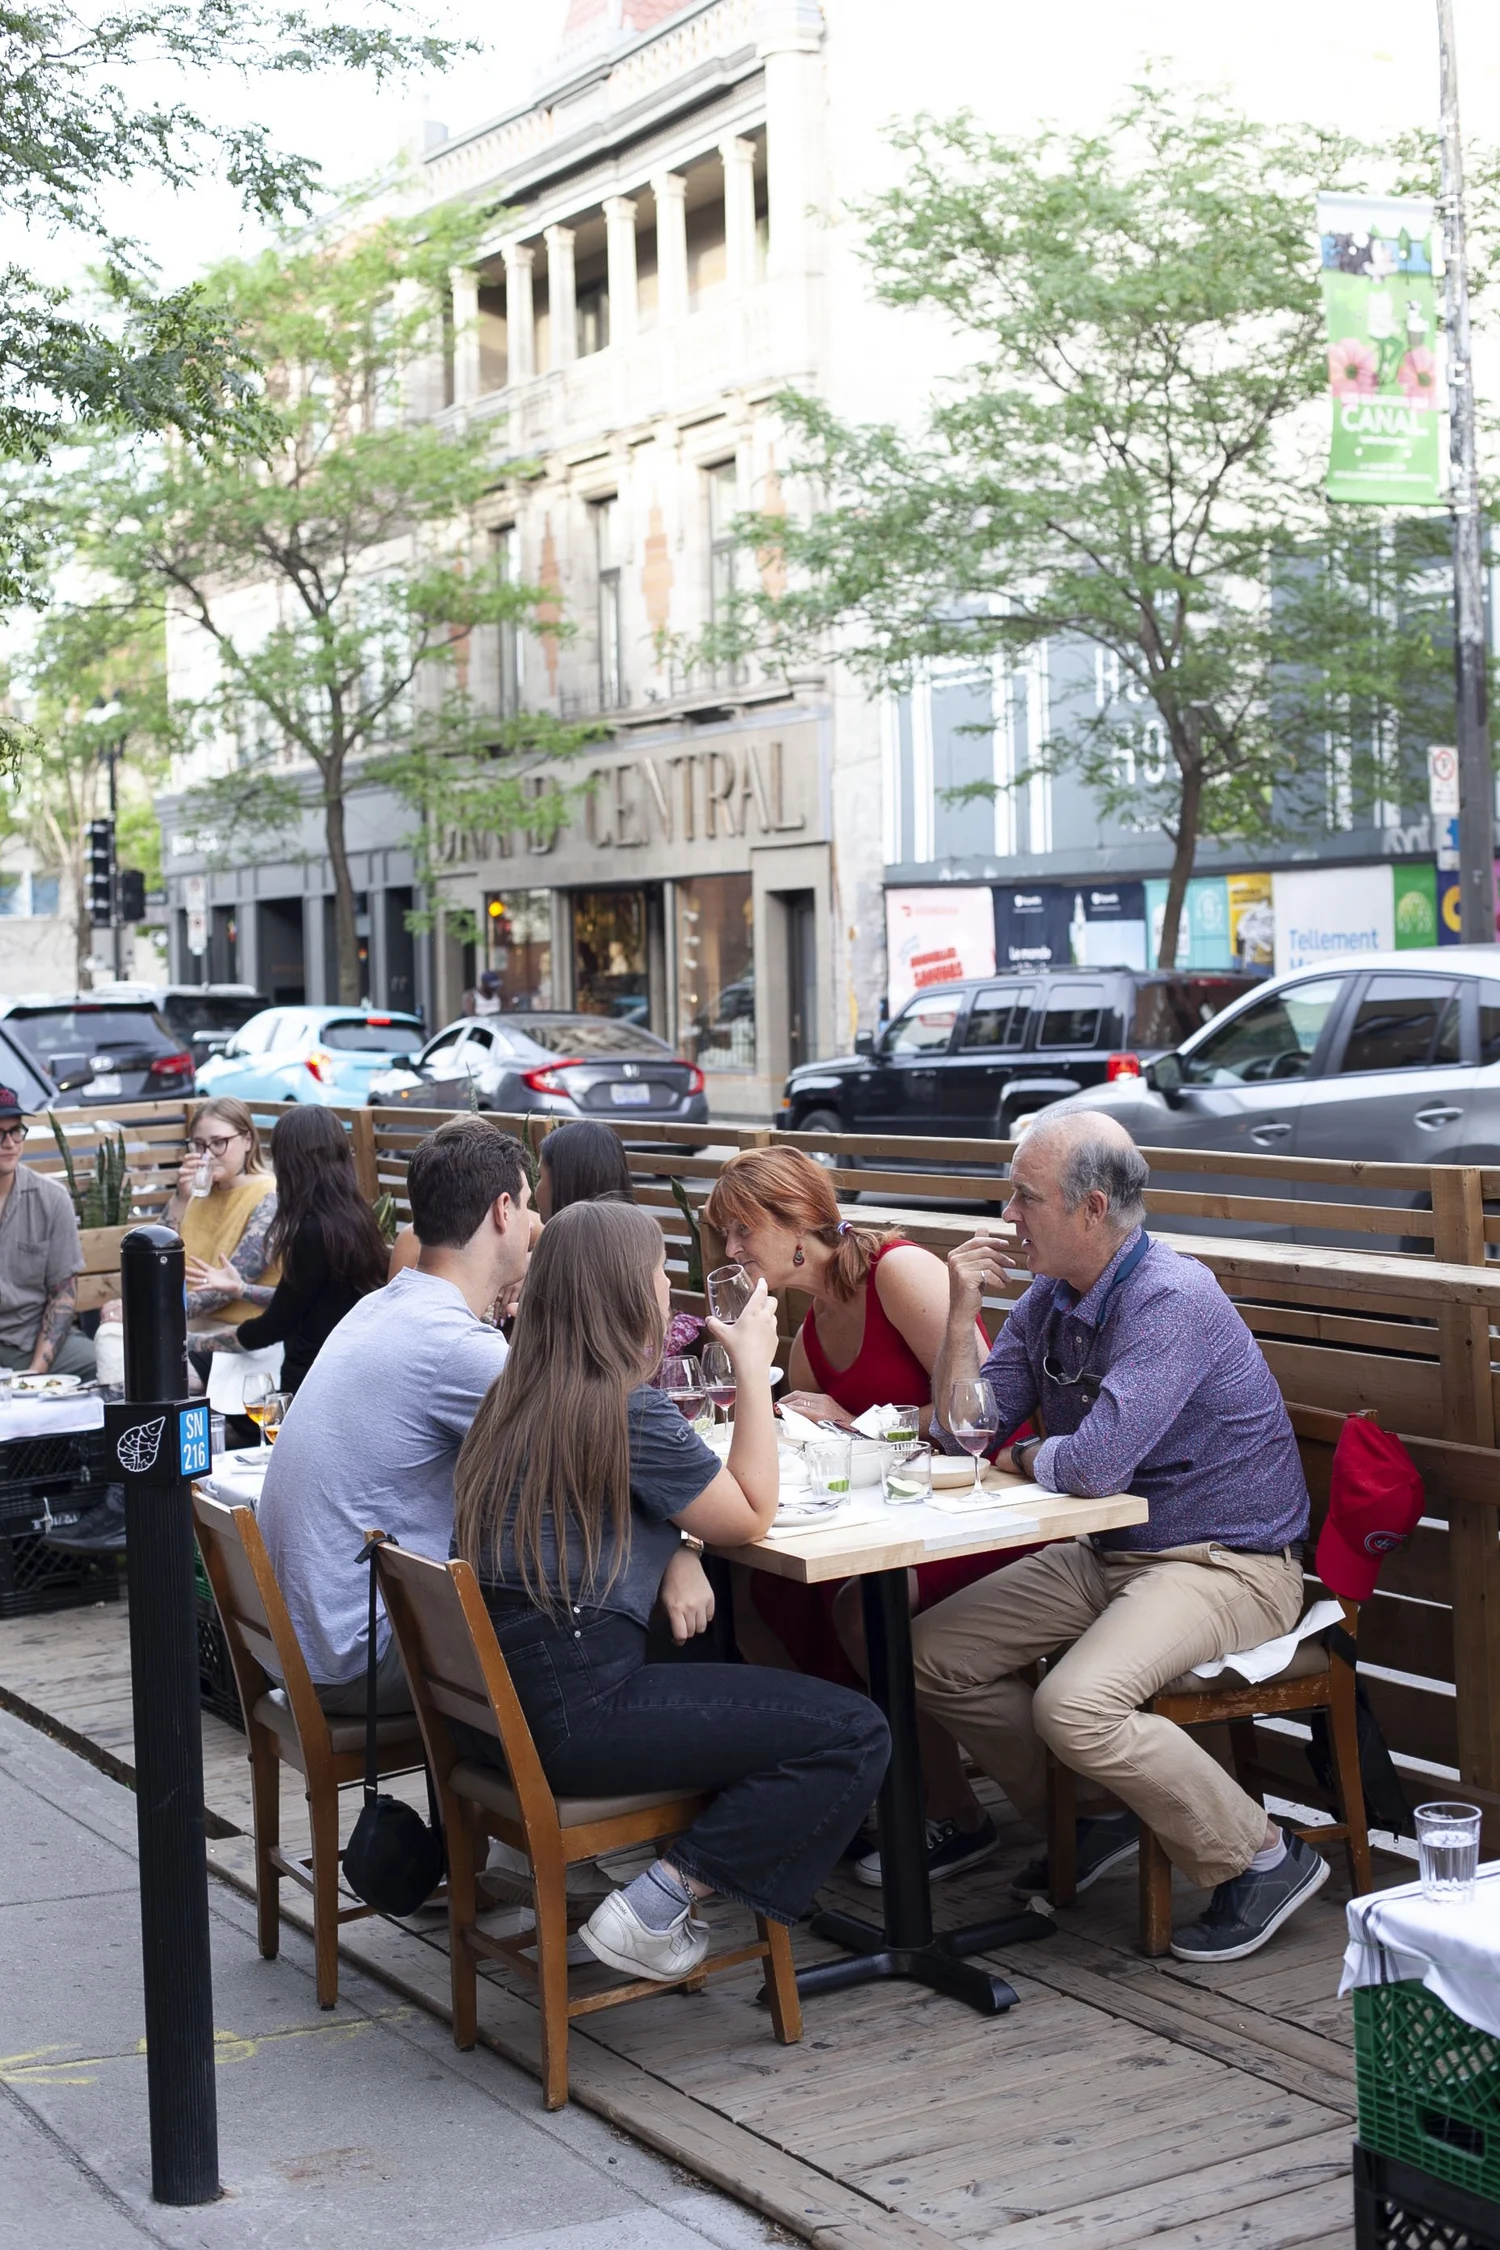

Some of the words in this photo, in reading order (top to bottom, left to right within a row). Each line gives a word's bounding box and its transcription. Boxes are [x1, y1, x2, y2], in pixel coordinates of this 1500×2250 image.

[1341, 406, 1430, 436] CANAL
[583, 741, 805, 850] CENTRAL
[1289, 928, 1379, 950] Tellement
[186, 1411, 204, 1439] SN
[183, 1442, 206, 1470] 216
